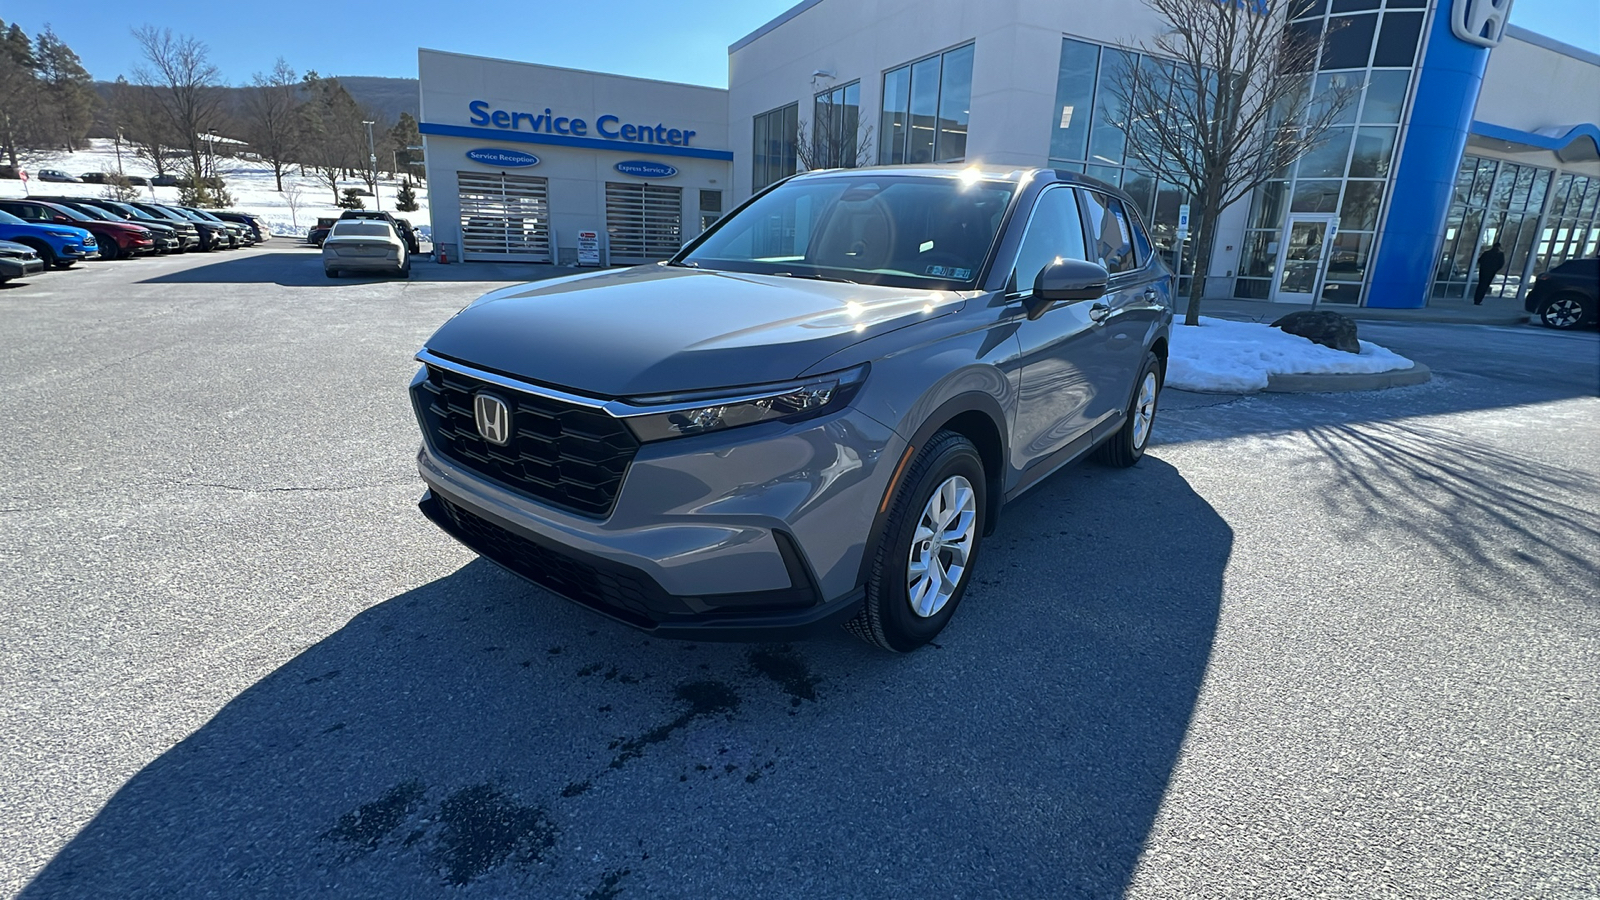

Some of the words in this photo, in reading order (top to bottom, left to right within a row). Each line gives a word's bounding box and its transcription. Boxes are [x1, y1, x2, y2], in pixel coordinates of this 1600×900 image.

[469, 100, 587, 136] Service
[596, 114, 696, 146] Center
[470, 151, 498, 160] Service
[499, 153, 535, 163] Reception
[618, 164, 642, 172] Express
[642, 166, 665, 174] Service
